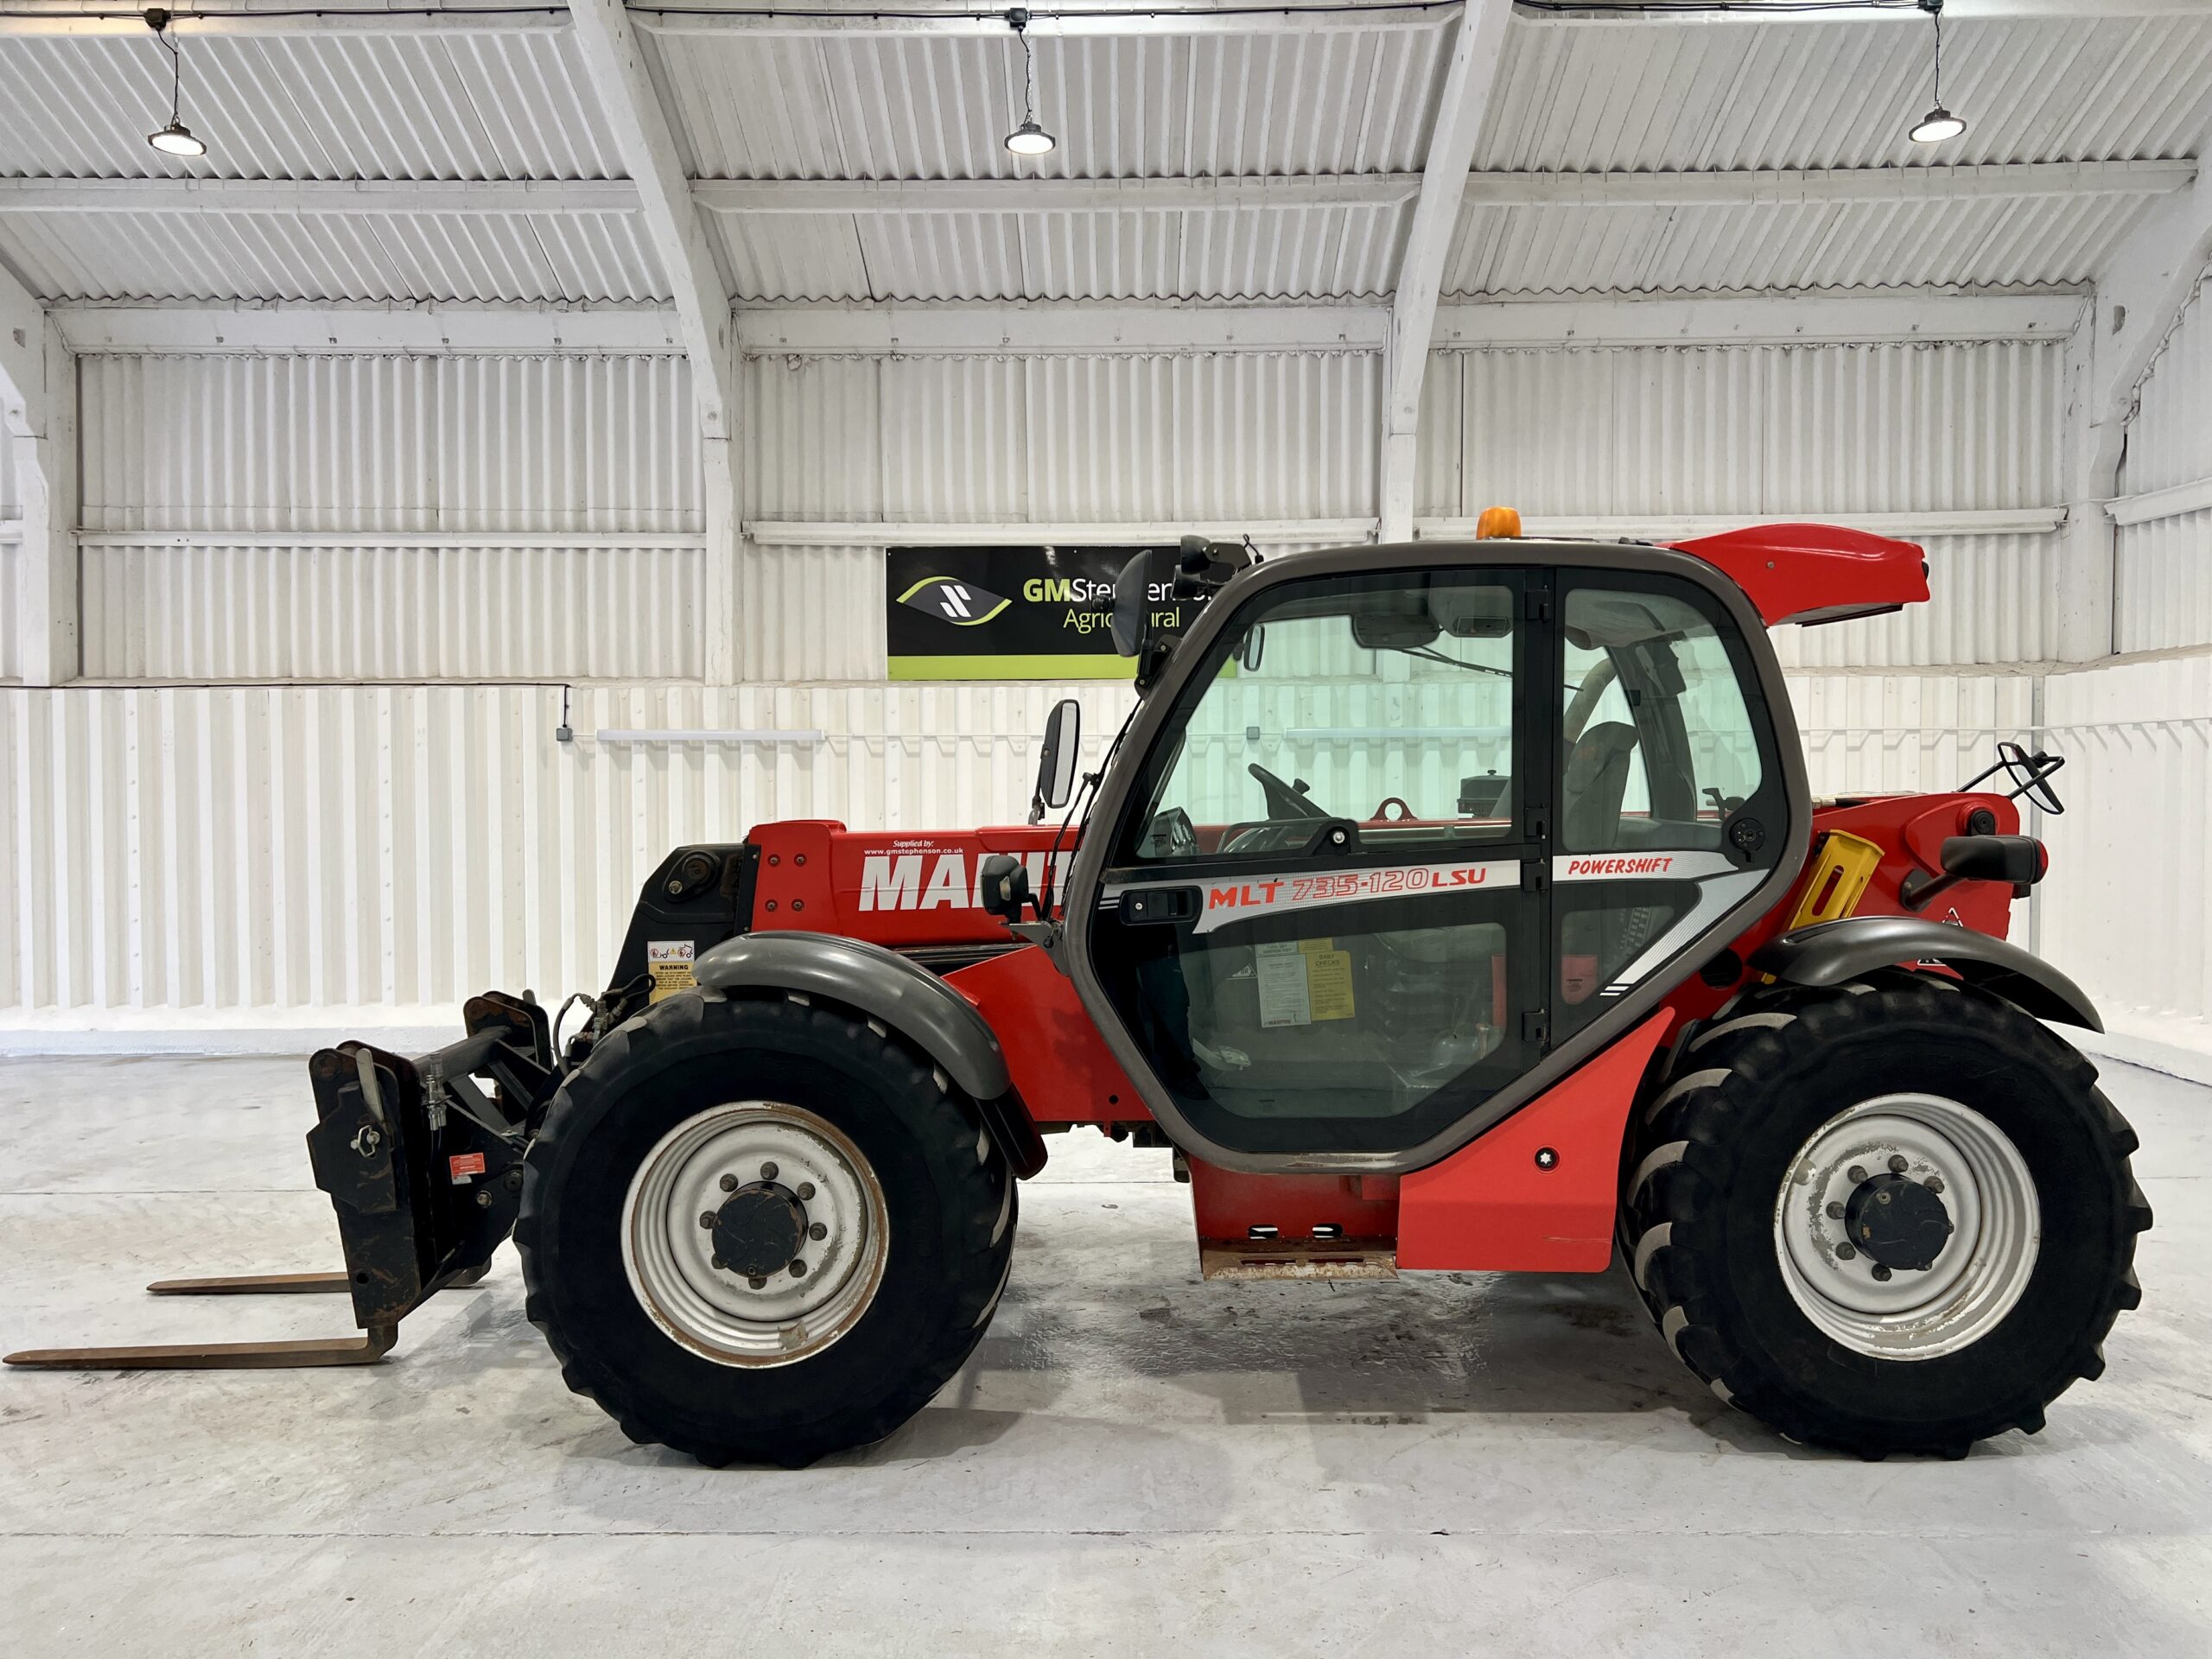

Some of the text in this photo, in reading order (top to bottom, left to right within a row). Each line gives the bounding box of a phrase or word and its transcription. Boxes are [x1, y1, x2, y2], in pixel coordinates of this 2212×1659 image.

[924, 839, 934, 848] by:
[864, 847, 964, 855] www.gmstephenson.co.uk
[1568, 856, 1674, 875] POWERSHIFT
[1208, 868, 1486, 910] MLT 735-120 LSU
